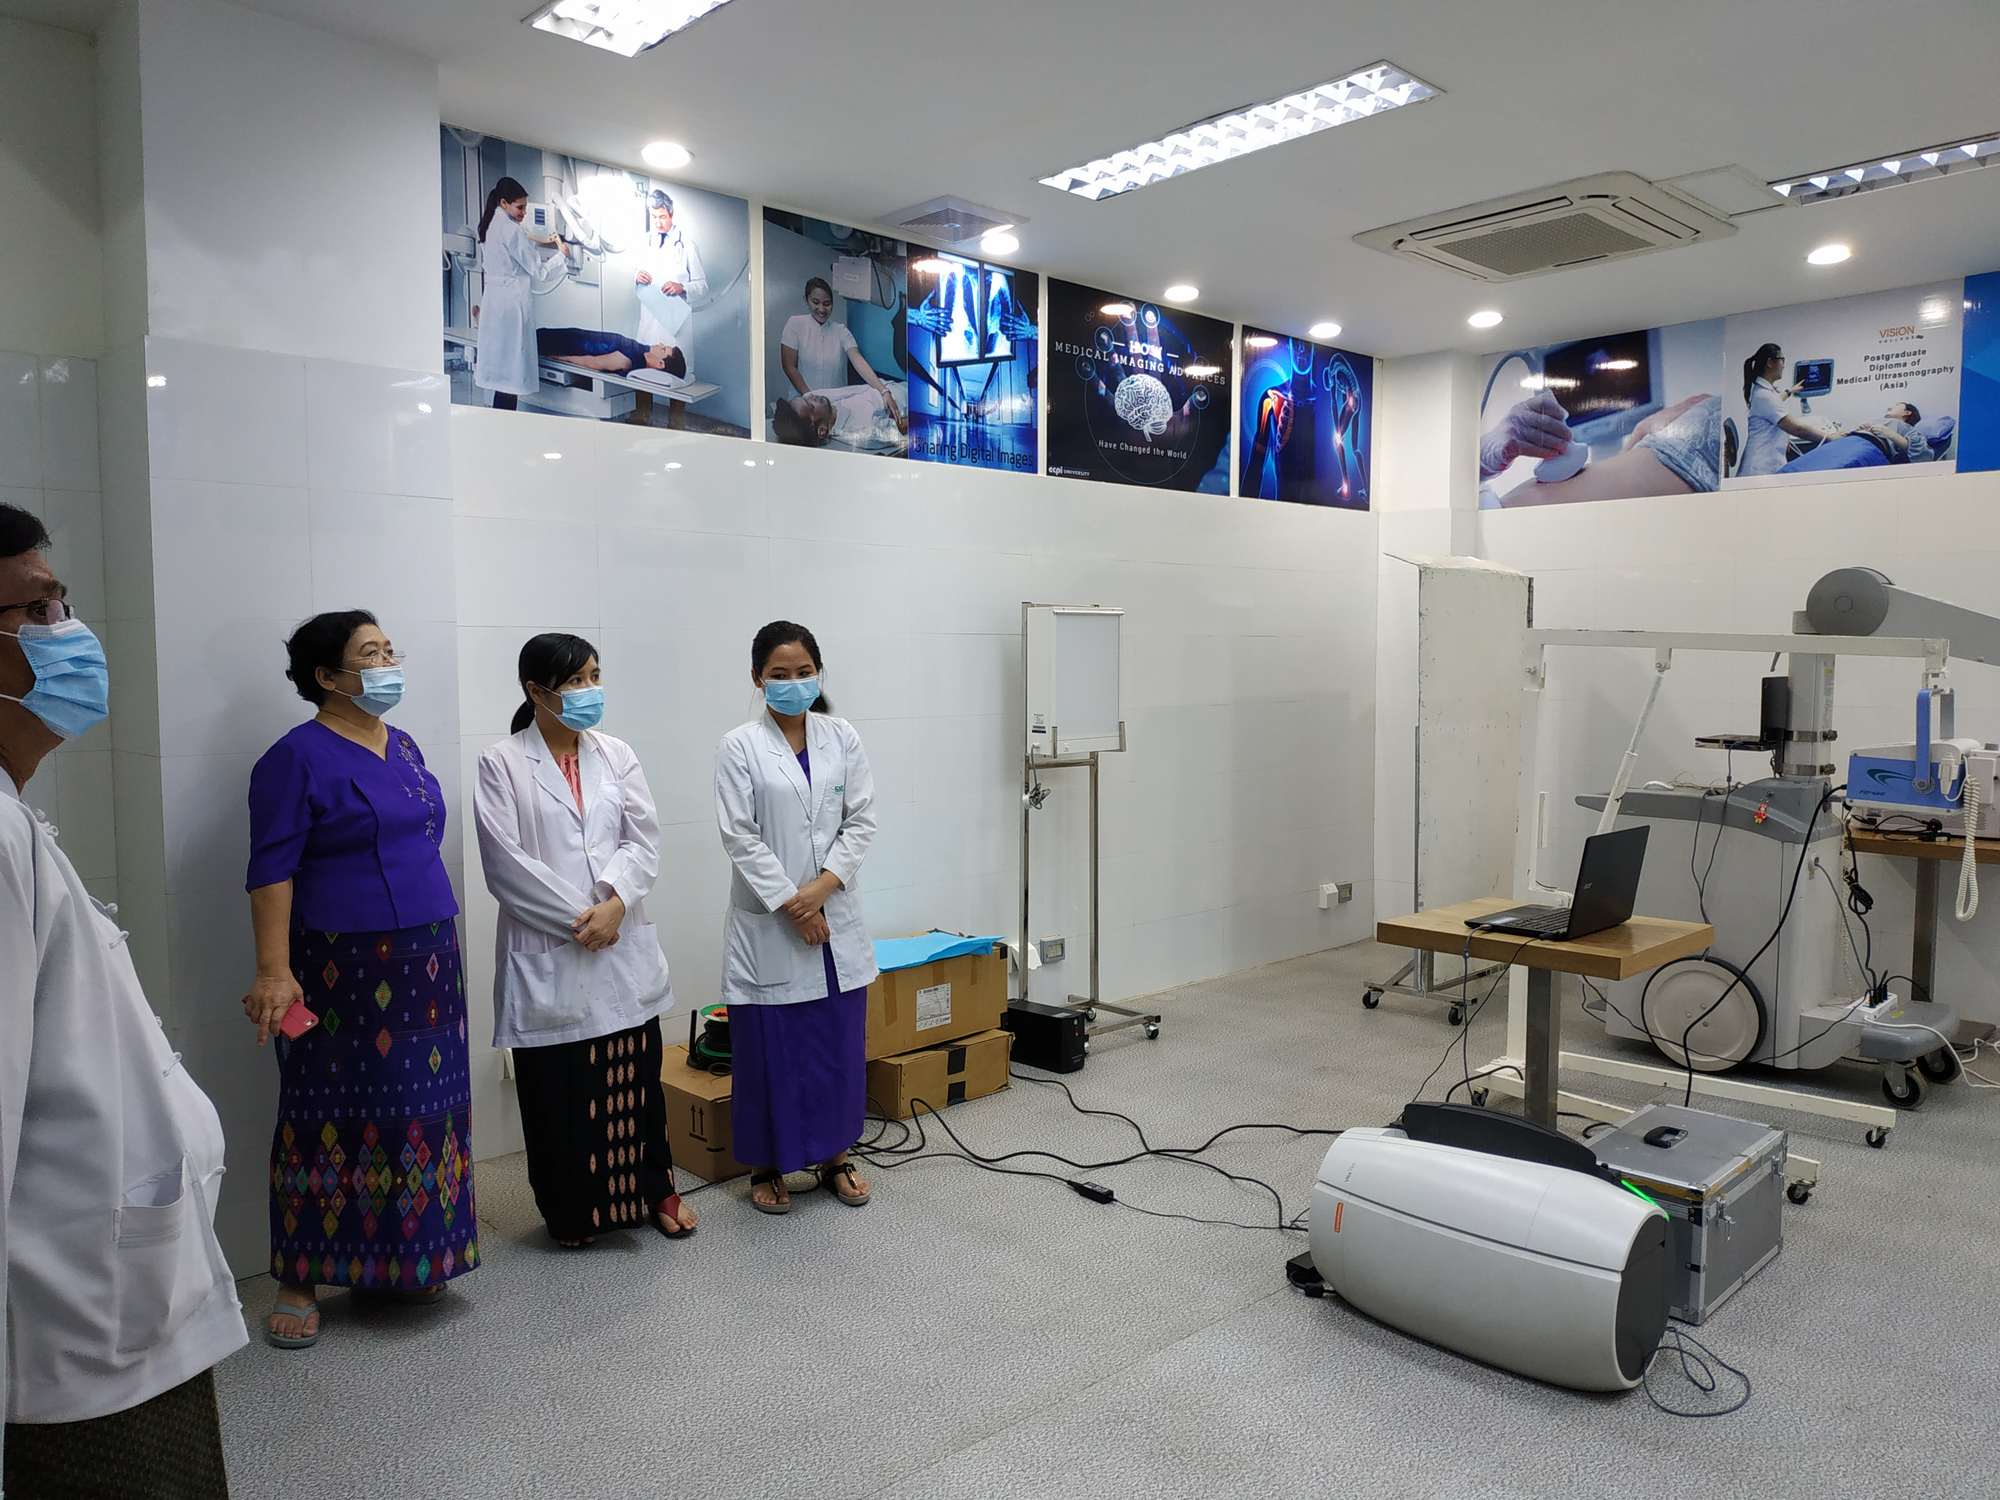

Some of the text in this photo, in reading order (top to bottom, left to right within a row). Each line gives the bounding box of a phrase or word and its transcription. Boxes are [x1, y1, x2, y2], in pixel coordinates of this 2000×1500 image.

[1880, 326, 1915, 338] VISION
[1129, 340, 1163, 361] HOW
[1863, 349, 1927, 362] Postgraduate
[1055, 341, 1226, 385] MEDICAL IMAGING ADCES
[1869, 362, 1907, 372] Diploma
[1836, 366, 1955, 385] Medical Ultrasonography
[1880, 380, 1908, 391] (Asia)
[960, 442, 995, 463] Digital
[997, 447, 1034, 469] Images
[1098, 439, 1187, 460] Have Changed the World
